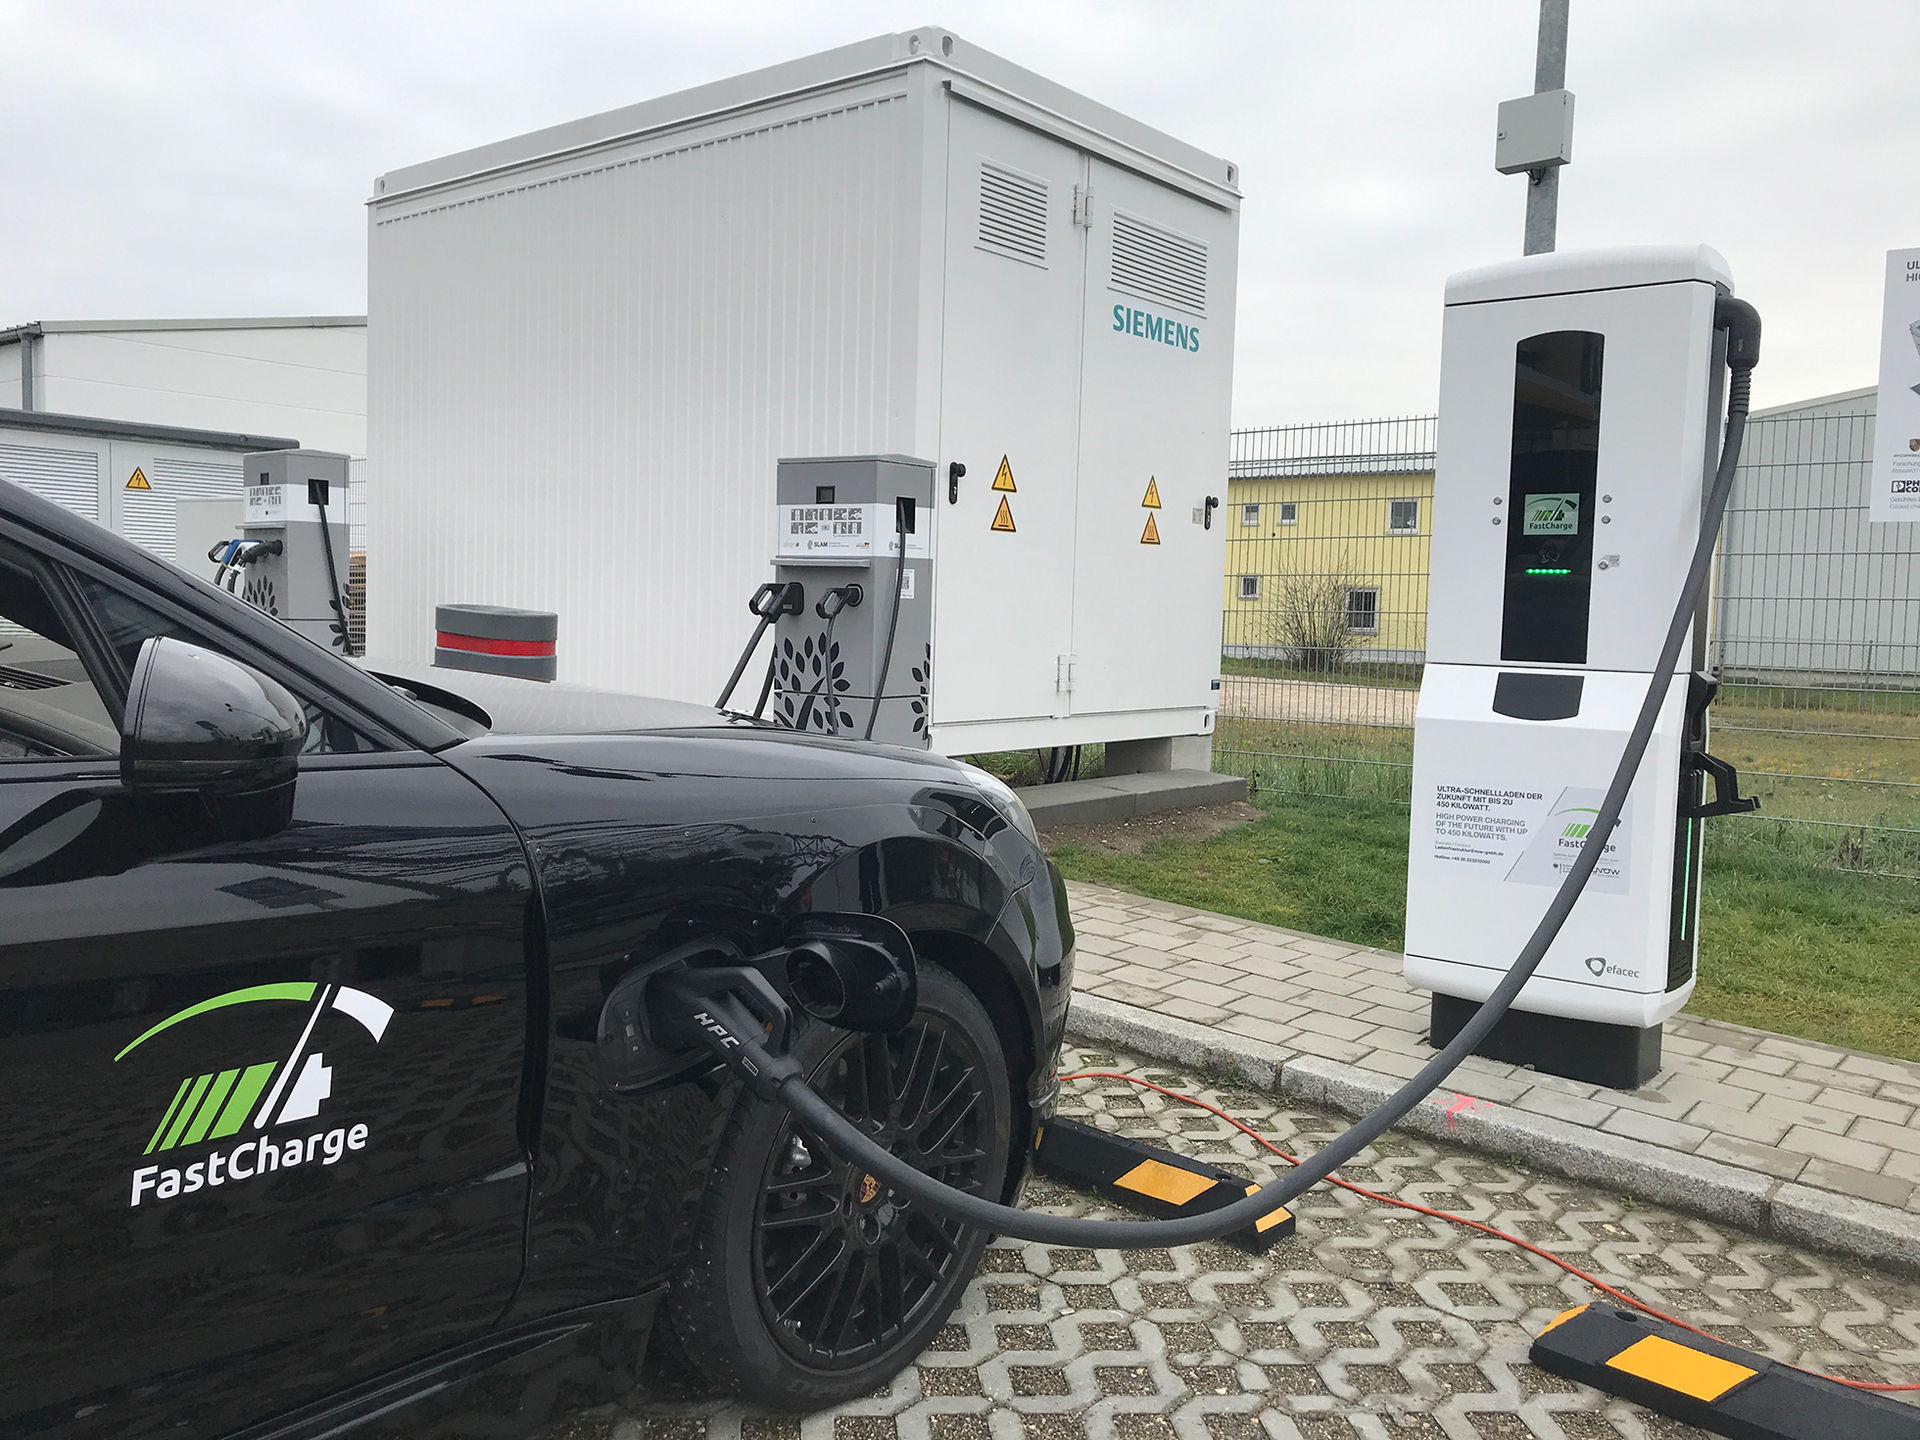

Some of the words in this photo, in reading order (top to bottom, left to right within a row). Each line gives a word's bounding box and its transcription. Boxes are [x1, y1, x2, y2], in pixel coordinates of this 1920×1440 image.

[1906, 273, 1920, 281] HI
[1113, 304, 1200, 353] SIEMENS
[1529, 522, 1573, 530] FastCharge
[1437, 785, 1525, 799] ULTRA-SCHNELLLADEN
[1526, 792, 1543, 800] DER
[1437, 793, 1472, 802] ZUKUNFT
[1502, 798, 1513, 806] ZU
[1451, 802, 1491, 812] KILOWATT.
[1436, 812, 1454, 820] HIGH
[1456, 814, 1483, 823] POWER
[1484, 816, 1526, 827] CHARGING
[1448, 821, 1462, 829] THE
[1463, 822, 1494, 832] FUTURE
[1495, 825, 1516, 833] WITH
[1447, 829, 1461, 837] 450
[1462, 830, 1508, 841] KILOWATTS.
[1558, 838, 1616, 853] FastCge
[1606, 964, 1640, 978] efacec
[694, 1012, 740, 1048] HPC
[130, 1123, 369, 1207] FastCharge
